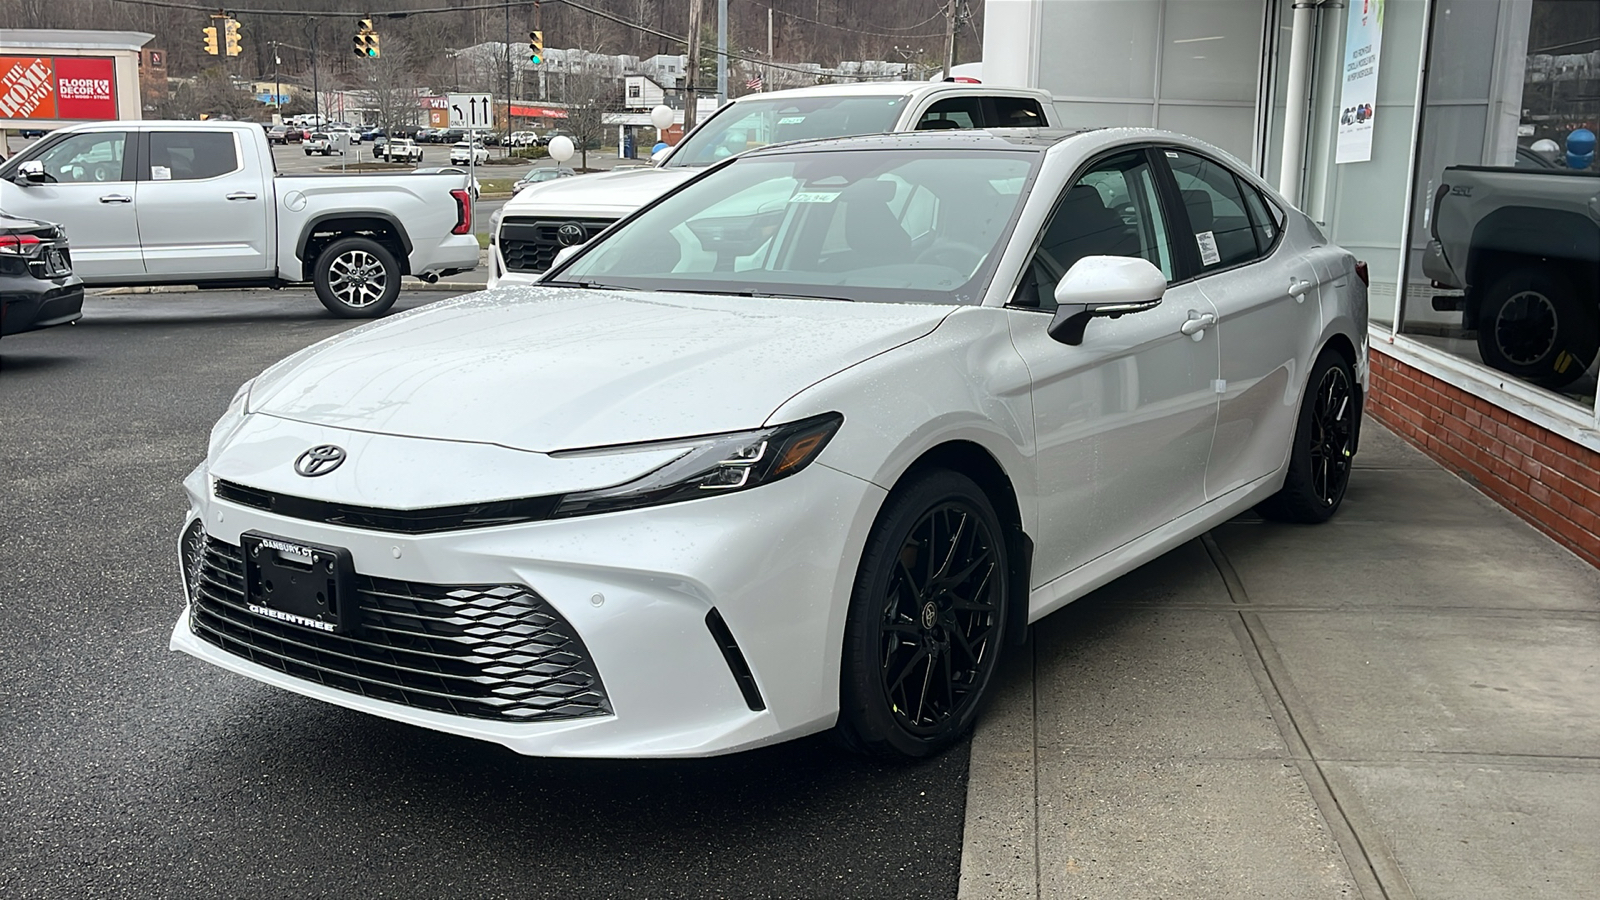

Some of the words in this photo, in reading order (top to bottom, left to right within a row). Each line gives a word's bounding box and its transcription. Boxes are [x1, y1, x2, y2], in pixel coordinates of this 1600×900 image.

[0, 58, 52, 118] HOME
[1, 61, 26, 88] THE
[59, 78, 93, 87] FLOOR
[19, 79, 53, 118] DEPOT
[60, 86, 94, 95] DECOR
[262, 539, 301, 555] DANBURY,
[301, 547, 313, 557] CT
[248, 604, 335, 632] GREENTREE
